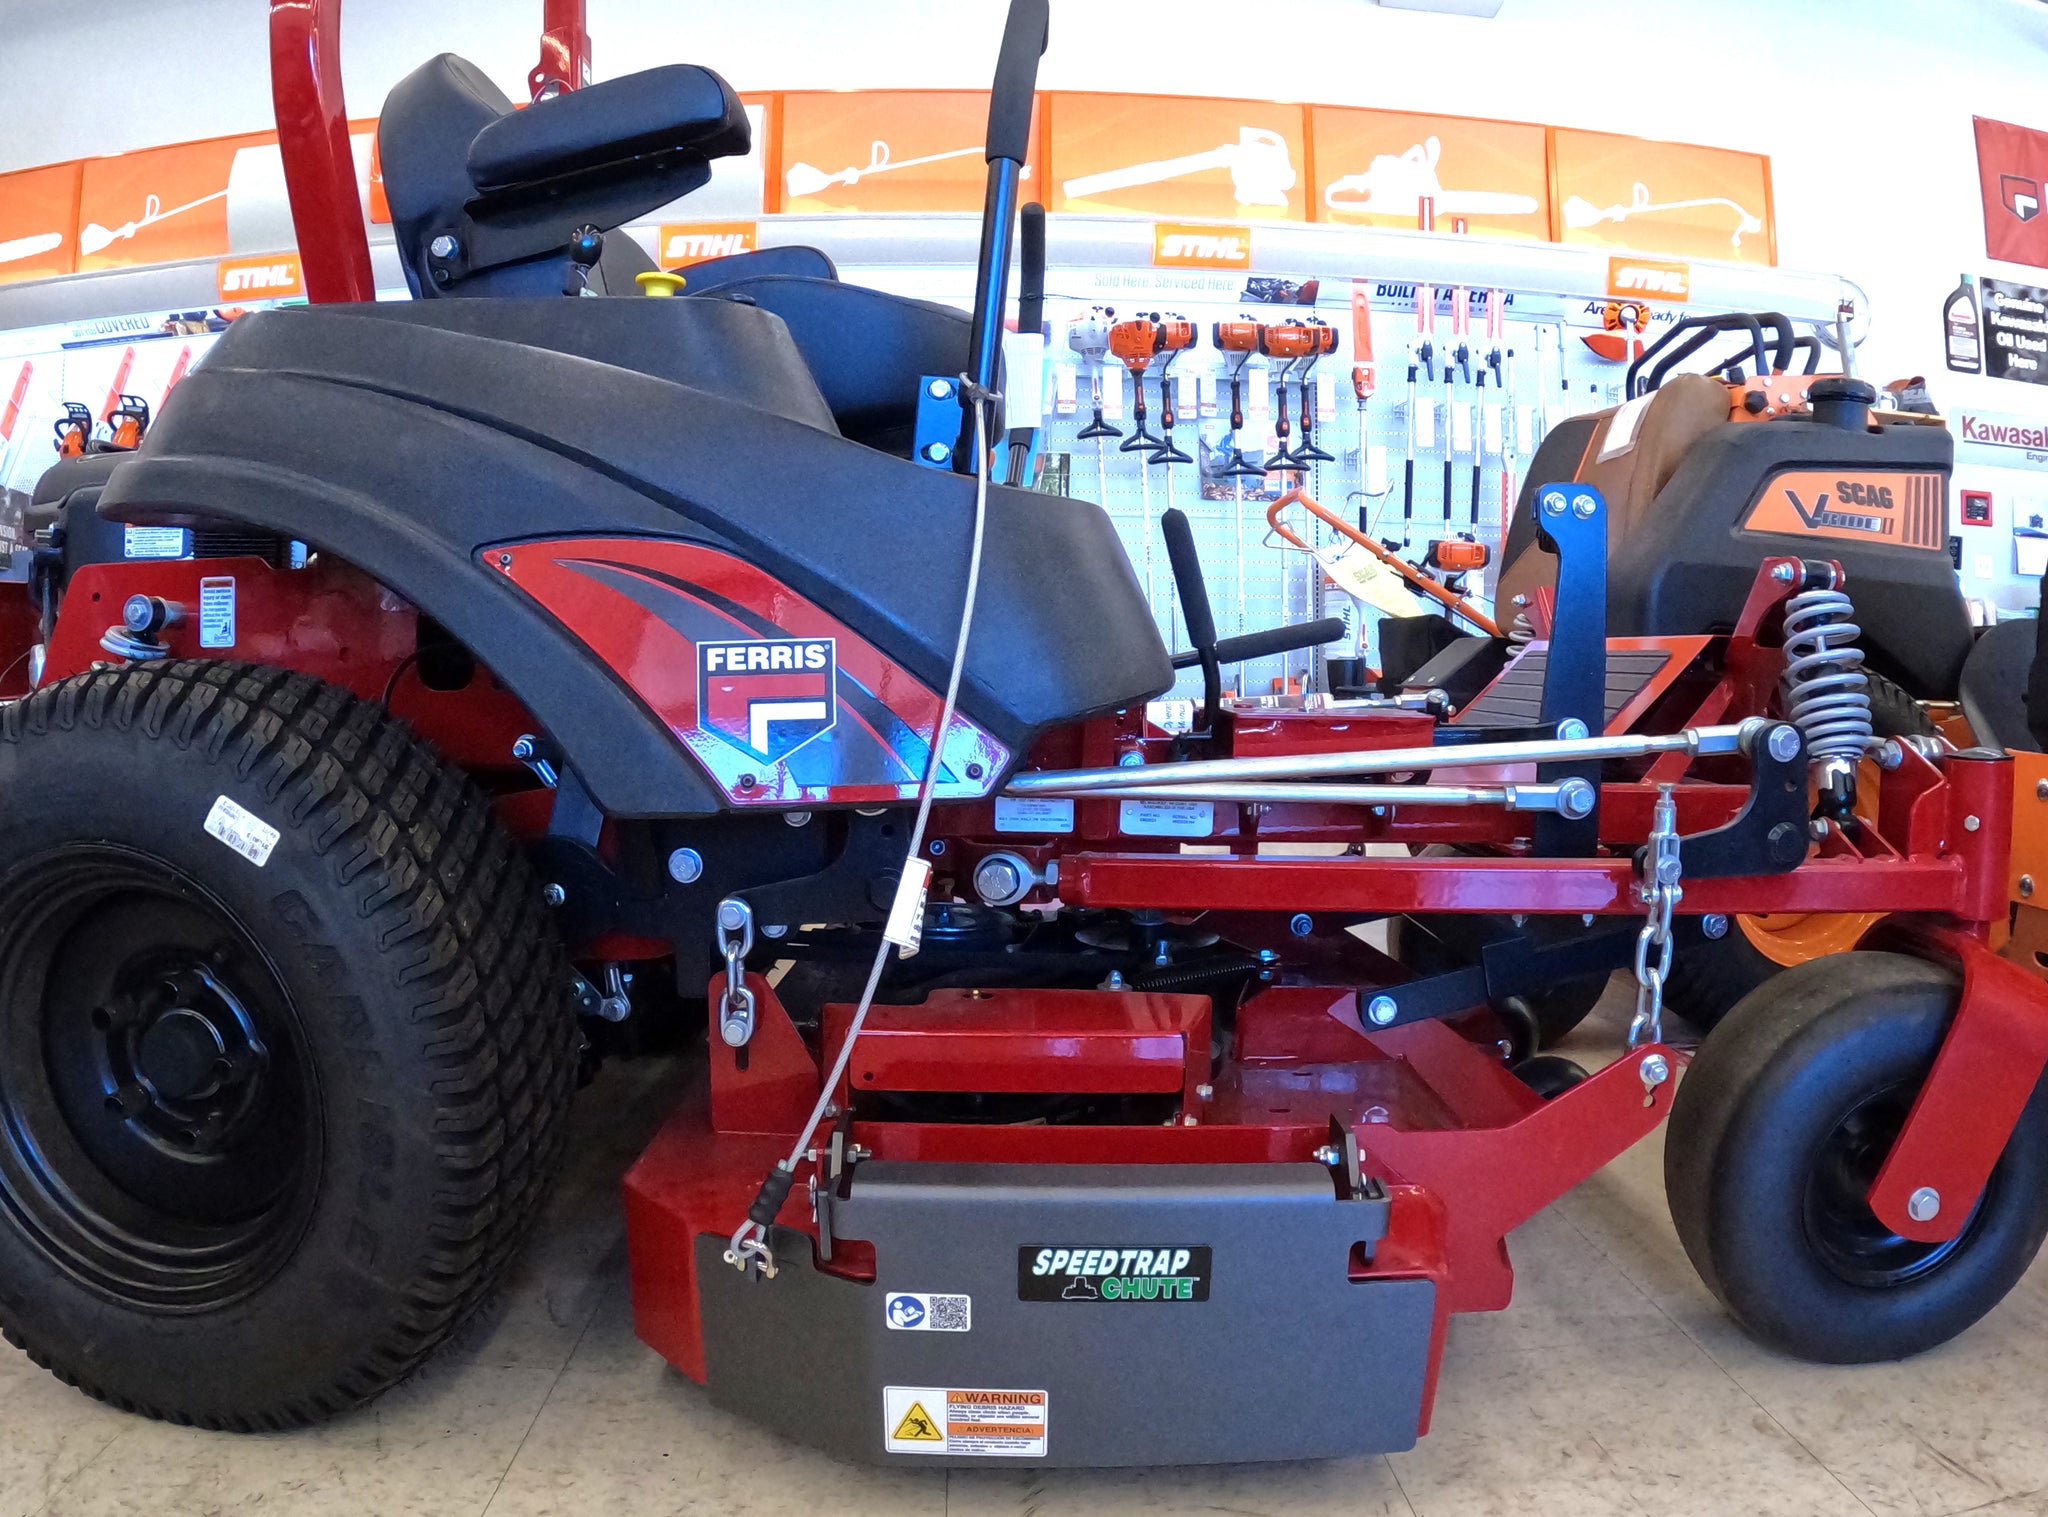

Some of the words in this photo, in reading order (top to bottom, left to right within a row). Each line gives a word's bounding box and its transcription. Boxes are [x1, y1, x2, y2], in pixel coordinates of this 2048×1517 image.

[665, 234, 751, 258] STIHL
[1160, 234, 1246, 260] STIHL
[223, 263, 294, 291] STIHL
[1094, 273, 1120, 287] Sold
[1123, 275, 1151, 288] Here.
[1154, 275, 1205, 290] Serviced
[1208, 277, 1237, 291] Here.
[1615, 267, 1688, 293] STIHL
[1994, 292, 2045, 313] Genuine
[1996, 331, 2014, 347] Oil
[2015, 335, 2047, 352] Used
[2008, 353, 2038, 370] Here
[1836, 481, 1894, 509] SCAG
[1342, 605, 1351, 640] STIHL
[707, 644, 827, 671] FERRIS
[1032, 1249, 1191, 1276] SPEEDTRAP
[1101, 1277, 1194, 1299] CHUTE
[965, 1393, 1041, 1404] WARNING
[966, 1426, 1031, 1434] ADVERTENCIA
